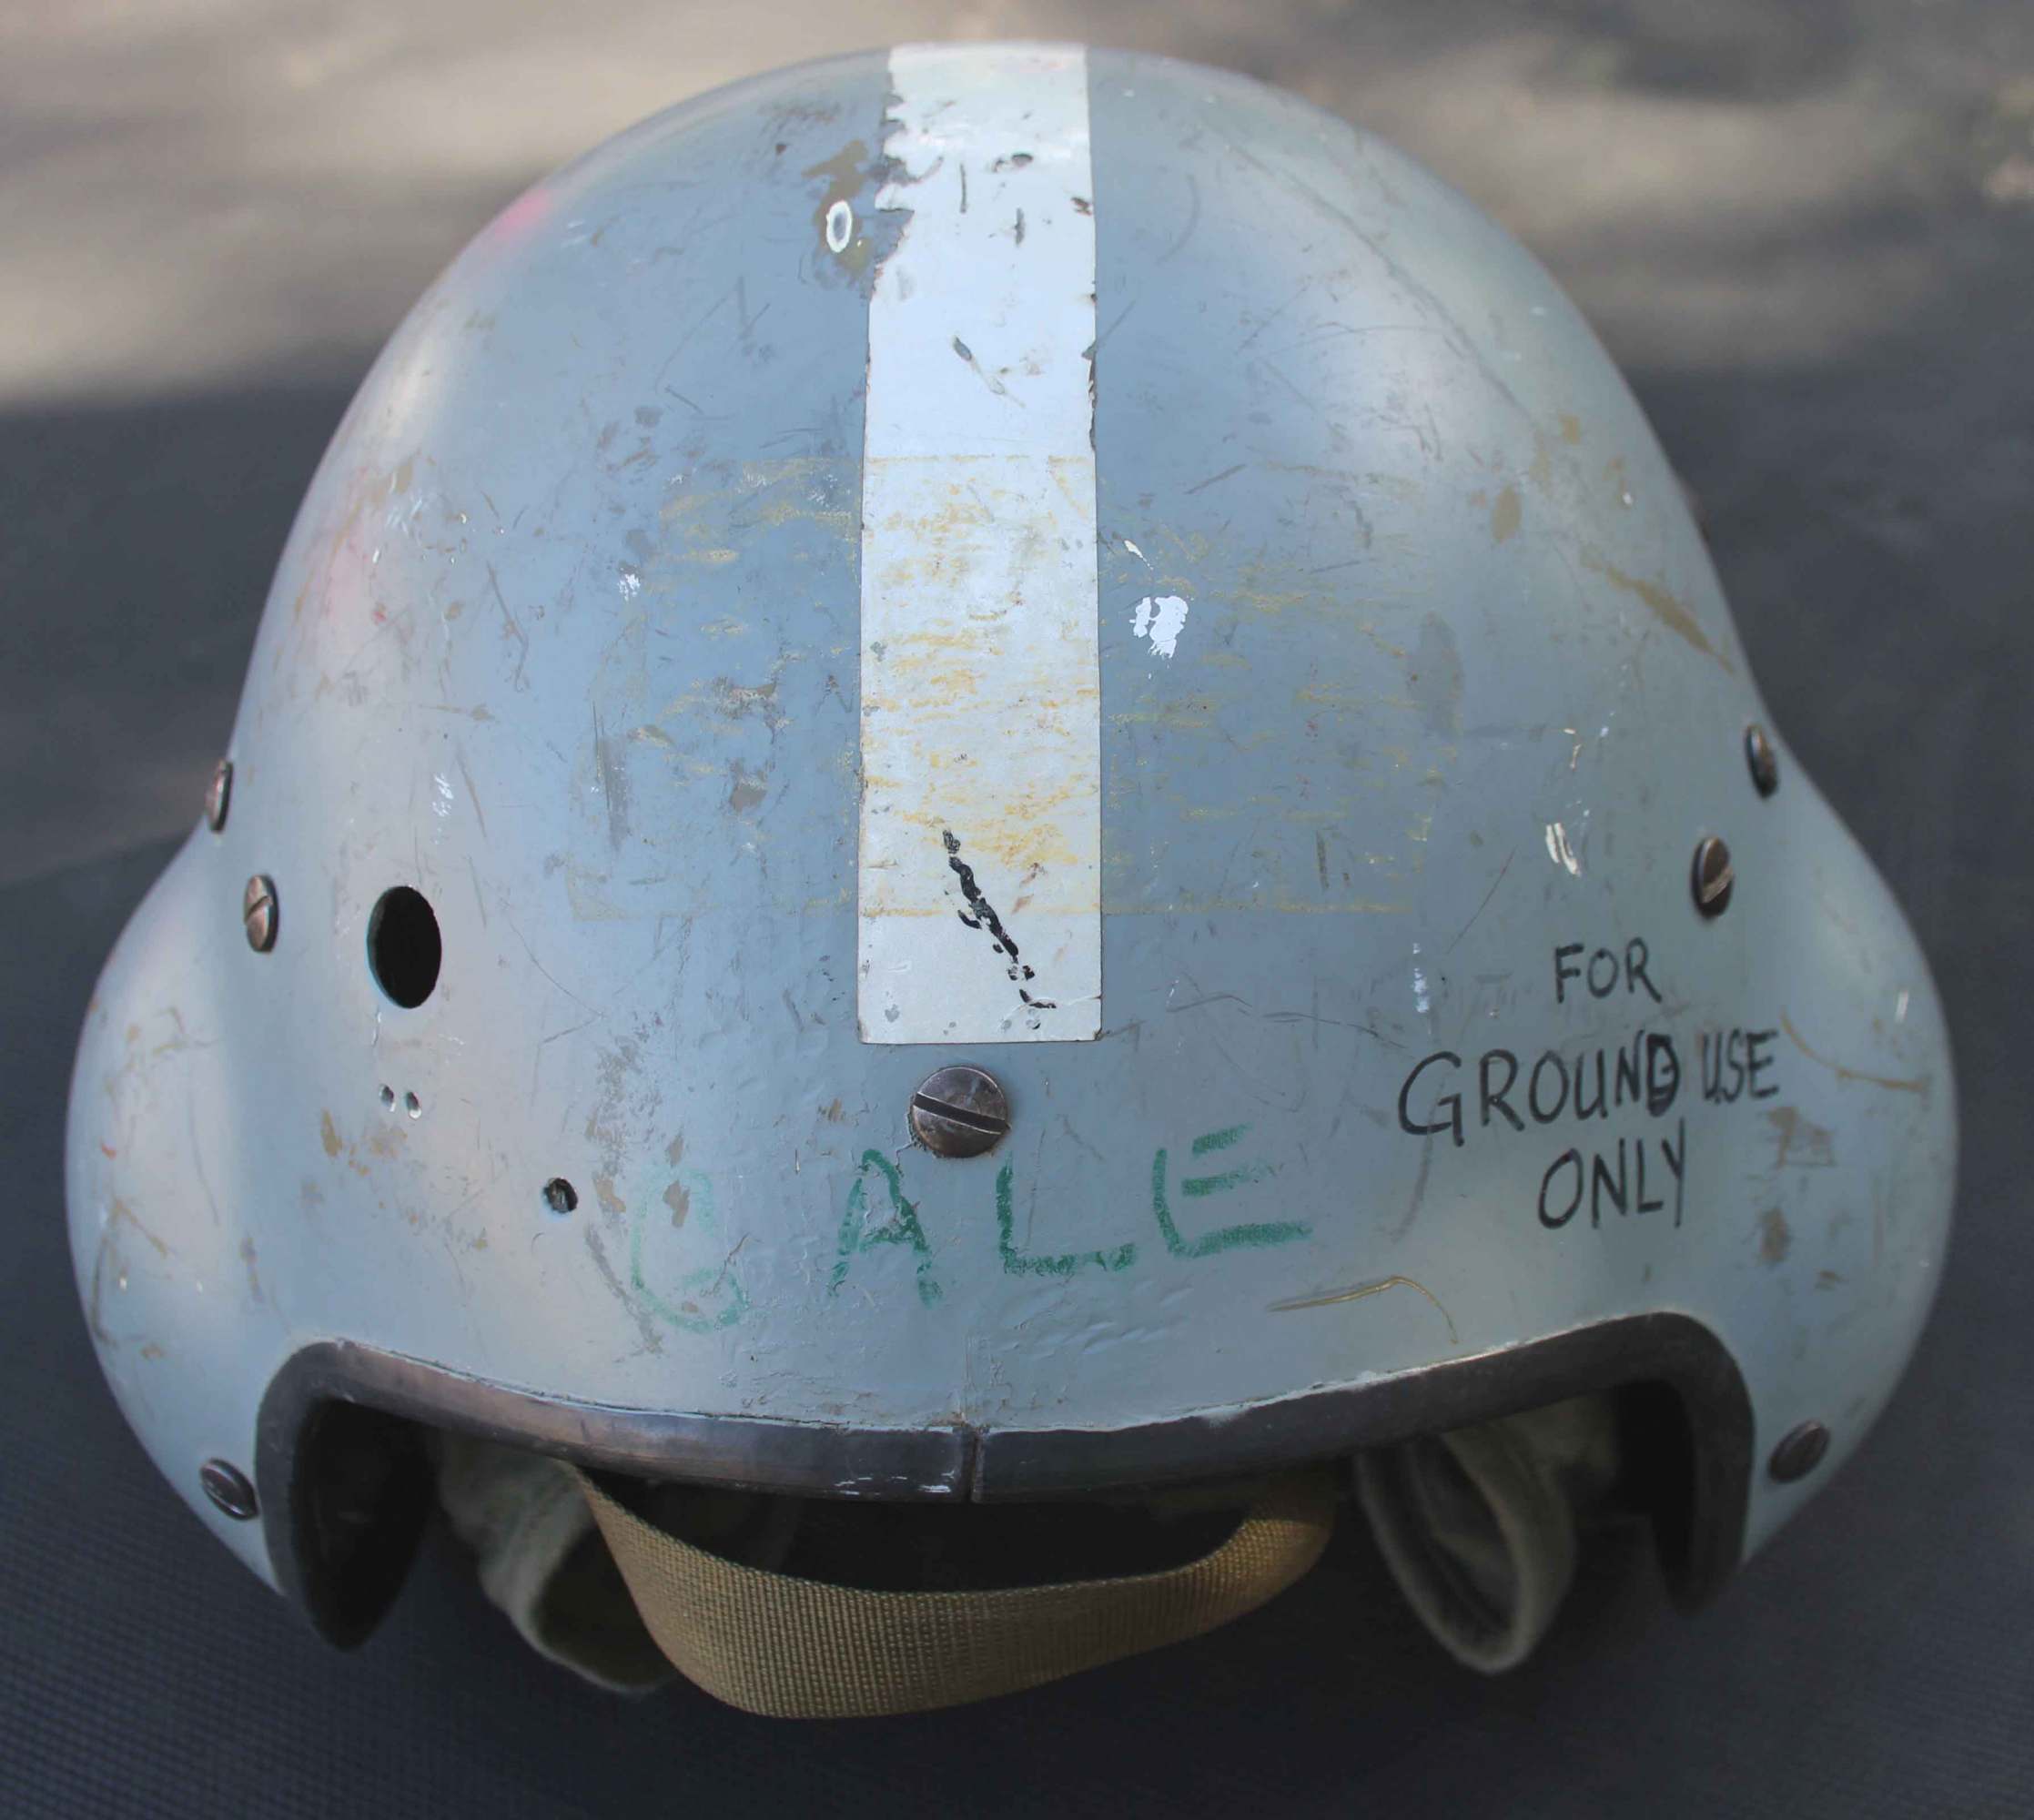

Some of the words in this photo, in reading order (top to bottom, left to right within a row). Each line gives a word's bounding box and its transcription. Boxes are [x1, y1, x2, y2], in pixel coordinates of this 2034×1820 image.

[1554, 937, 1663, 1004] FOR
[1398, 1029, 1682, 1147] GROUND
[1702, 1027, 1780, 1105] USE
[1537, 1117, 1686, 1228] ONLY
